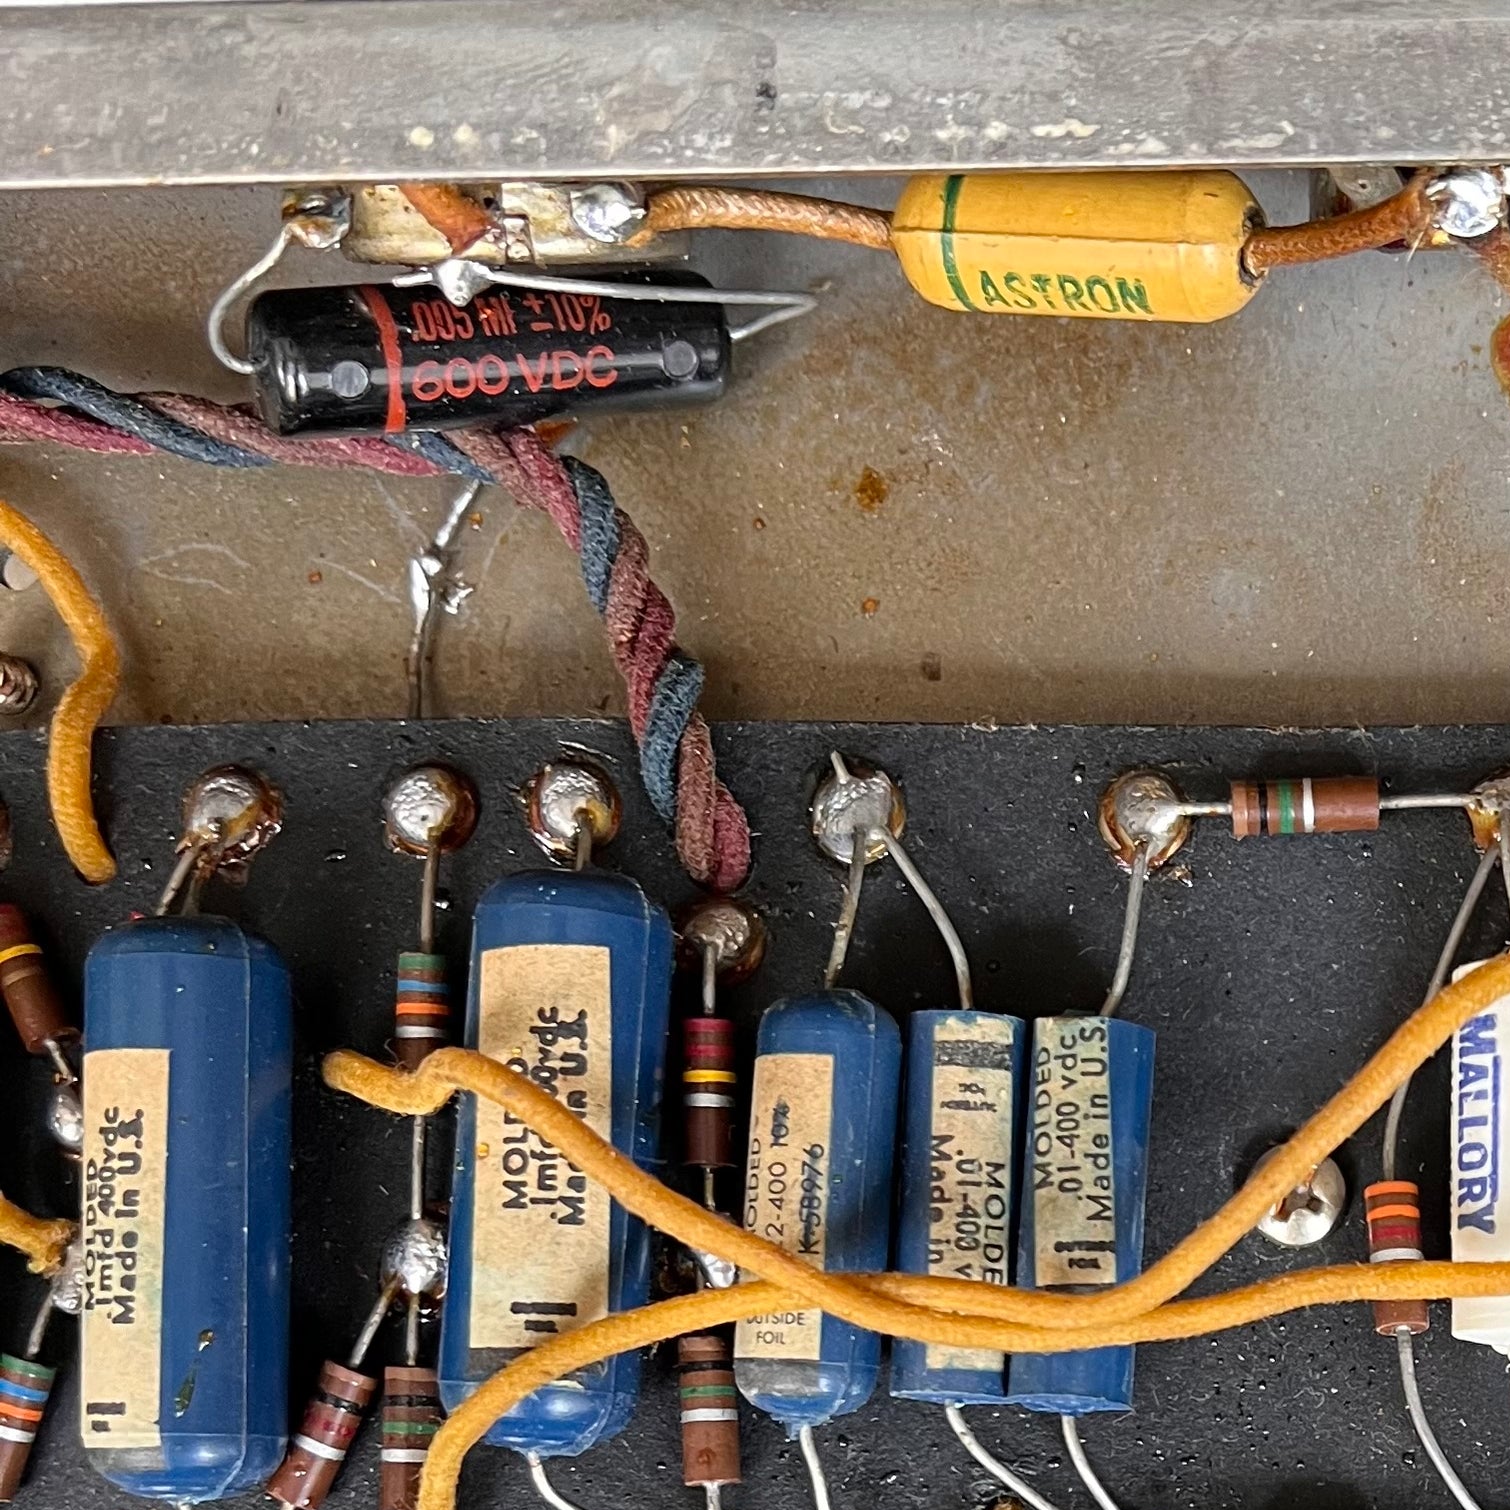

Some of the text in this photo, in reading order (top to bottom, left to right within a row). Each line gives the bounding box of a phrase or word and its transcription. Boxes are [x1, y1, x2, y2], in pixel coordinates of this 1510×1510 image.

[411, 301, 474, 342] .005
[979, 269, 1155, 315] ASTRON
[411, 345, 619, 401] 600 VDC
[1053, 1034, 1078, 1090] vdc
[502, 1057, 530, 1209] MOLD
[1083, 1093, 1109, 1121] in
[1457, 1013, 1498, 1235] MALLORY
[114, 1189, 141, 1219] in
[558, 1153, 587, 1225] Ma
[745, 1138, 761, 1233] OLDED
[765, 1161, 787, 1249] 2-400
[930, 1134, 955, 1223] Made
[1085, 1133, 1113, 1222] Made
[85, 1158, 98, 1310] MOLDED
[983, 1161, 1006, 1284] MOLDE
[111, 1230, 139, 1325] Made
[756, 1331, 785, 1345] FOIL
